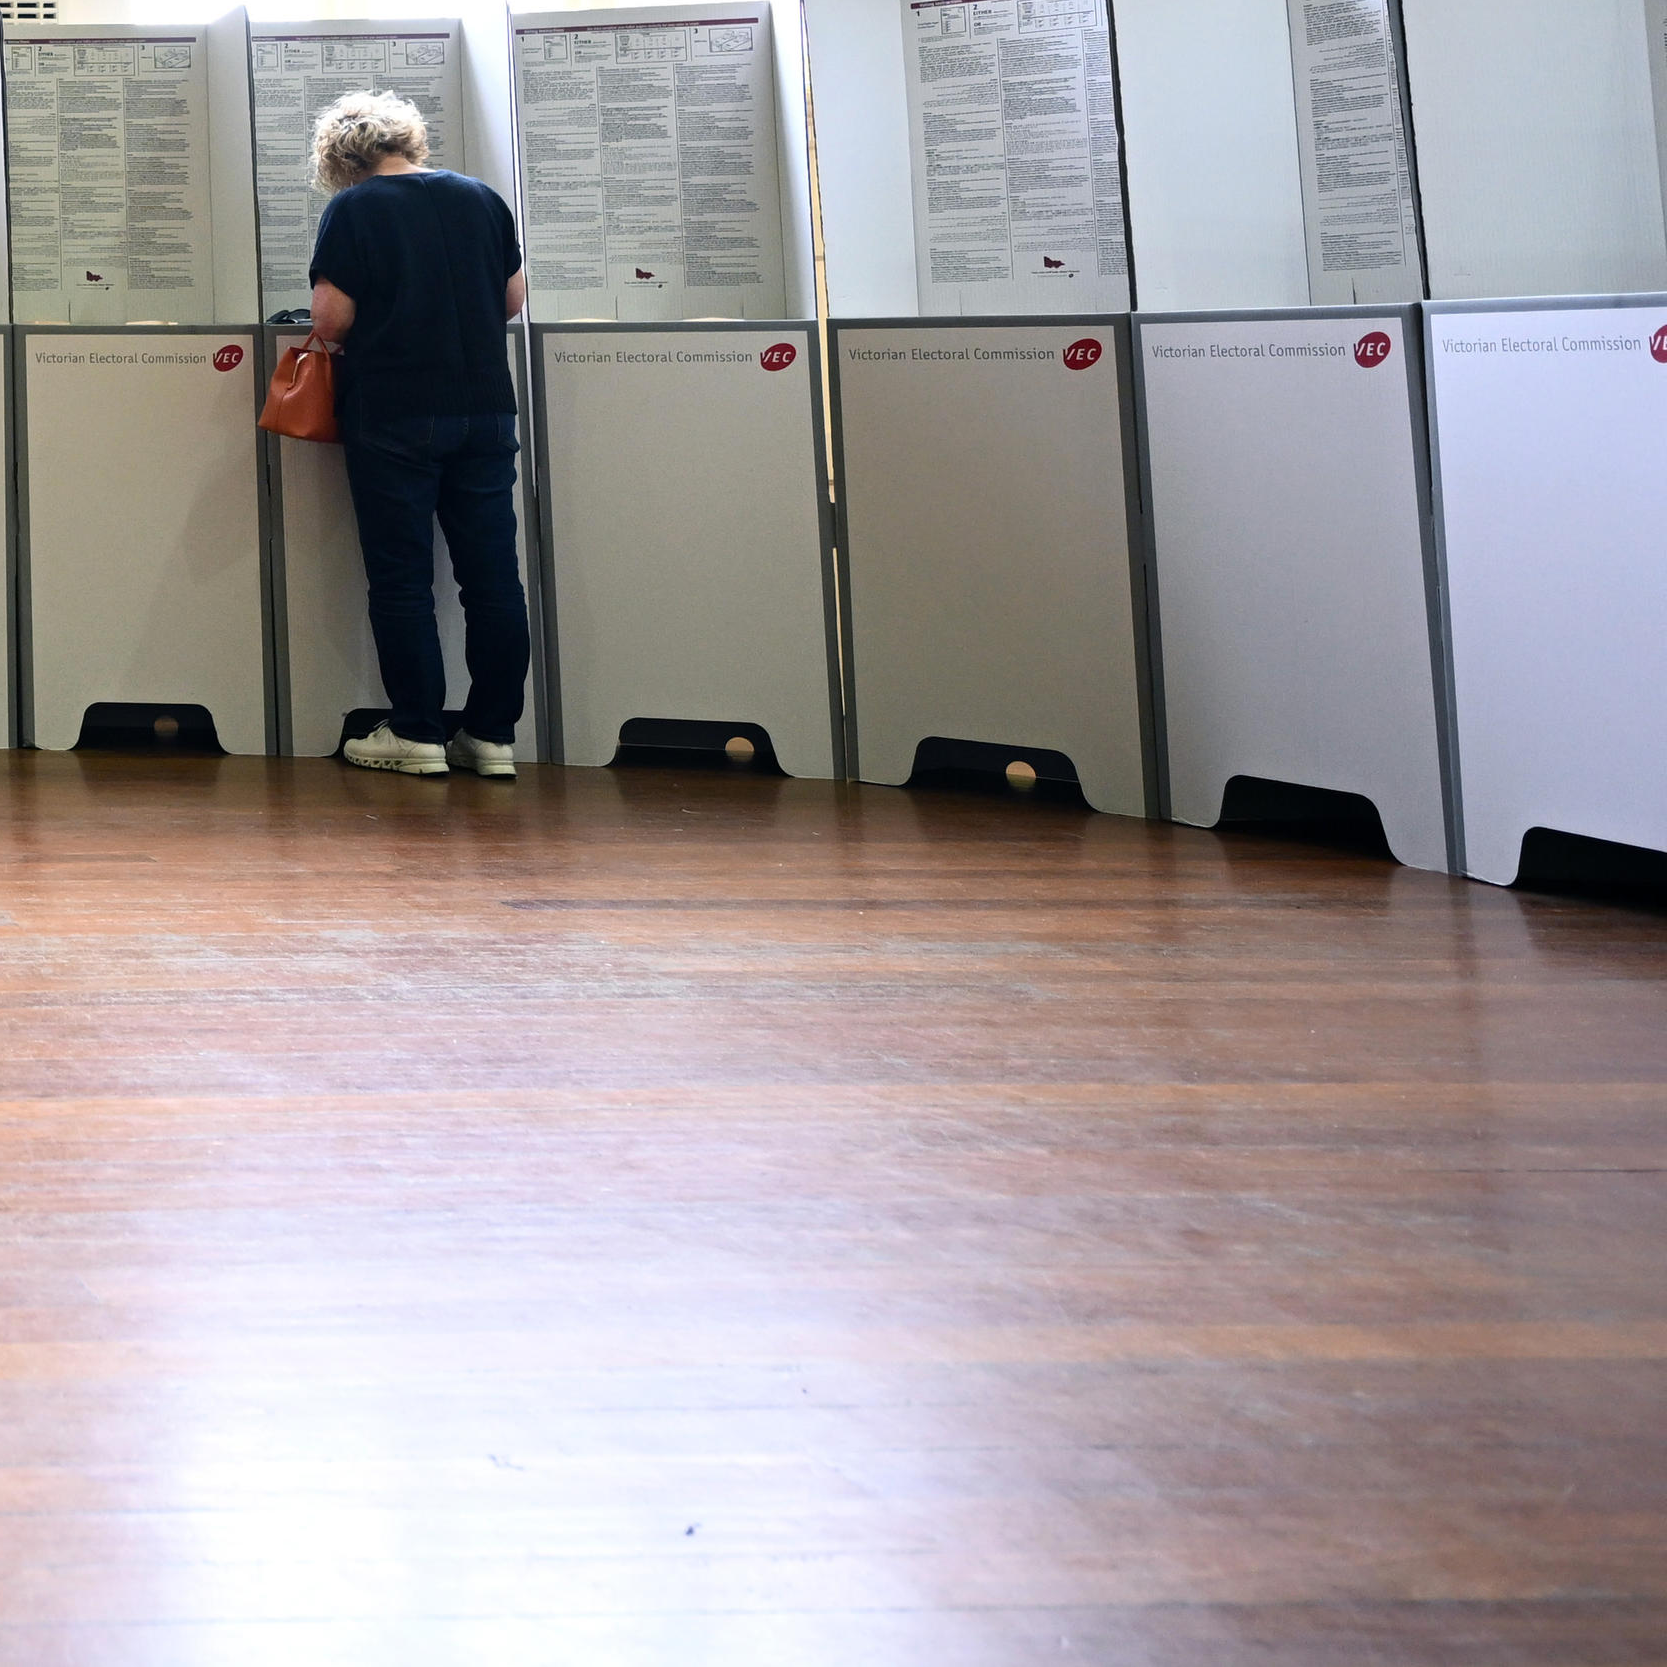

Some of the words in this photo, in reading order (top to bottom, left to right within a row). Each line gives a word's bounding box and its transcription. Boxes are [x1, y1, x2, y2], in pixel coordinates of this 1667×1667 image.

[1443, 338, 1496, 352] Victorian
[1502, 337, 1557, 352] Electoral
[1562, 336, 1641, 351] Commission
[849, 348, 906, 360] Victorian
[912, 348, 968, 360] Electoral
[974, 348, 1054, 359] Commission
[1152, 345, 1205, 358] Victorian
[1210, 344, 1264, 357] Electoral
[1269, 343, 1345, 356] Commission
[36, 352, 85, 363] Victorian
[90, 353, 137, 363] Electoral
[142, 353, 206, 364] Commission
[555, 351, 610, 363] Victorian
[616, 351, 672, 363] Electoral
[677, 351, 752, 362] Commission
